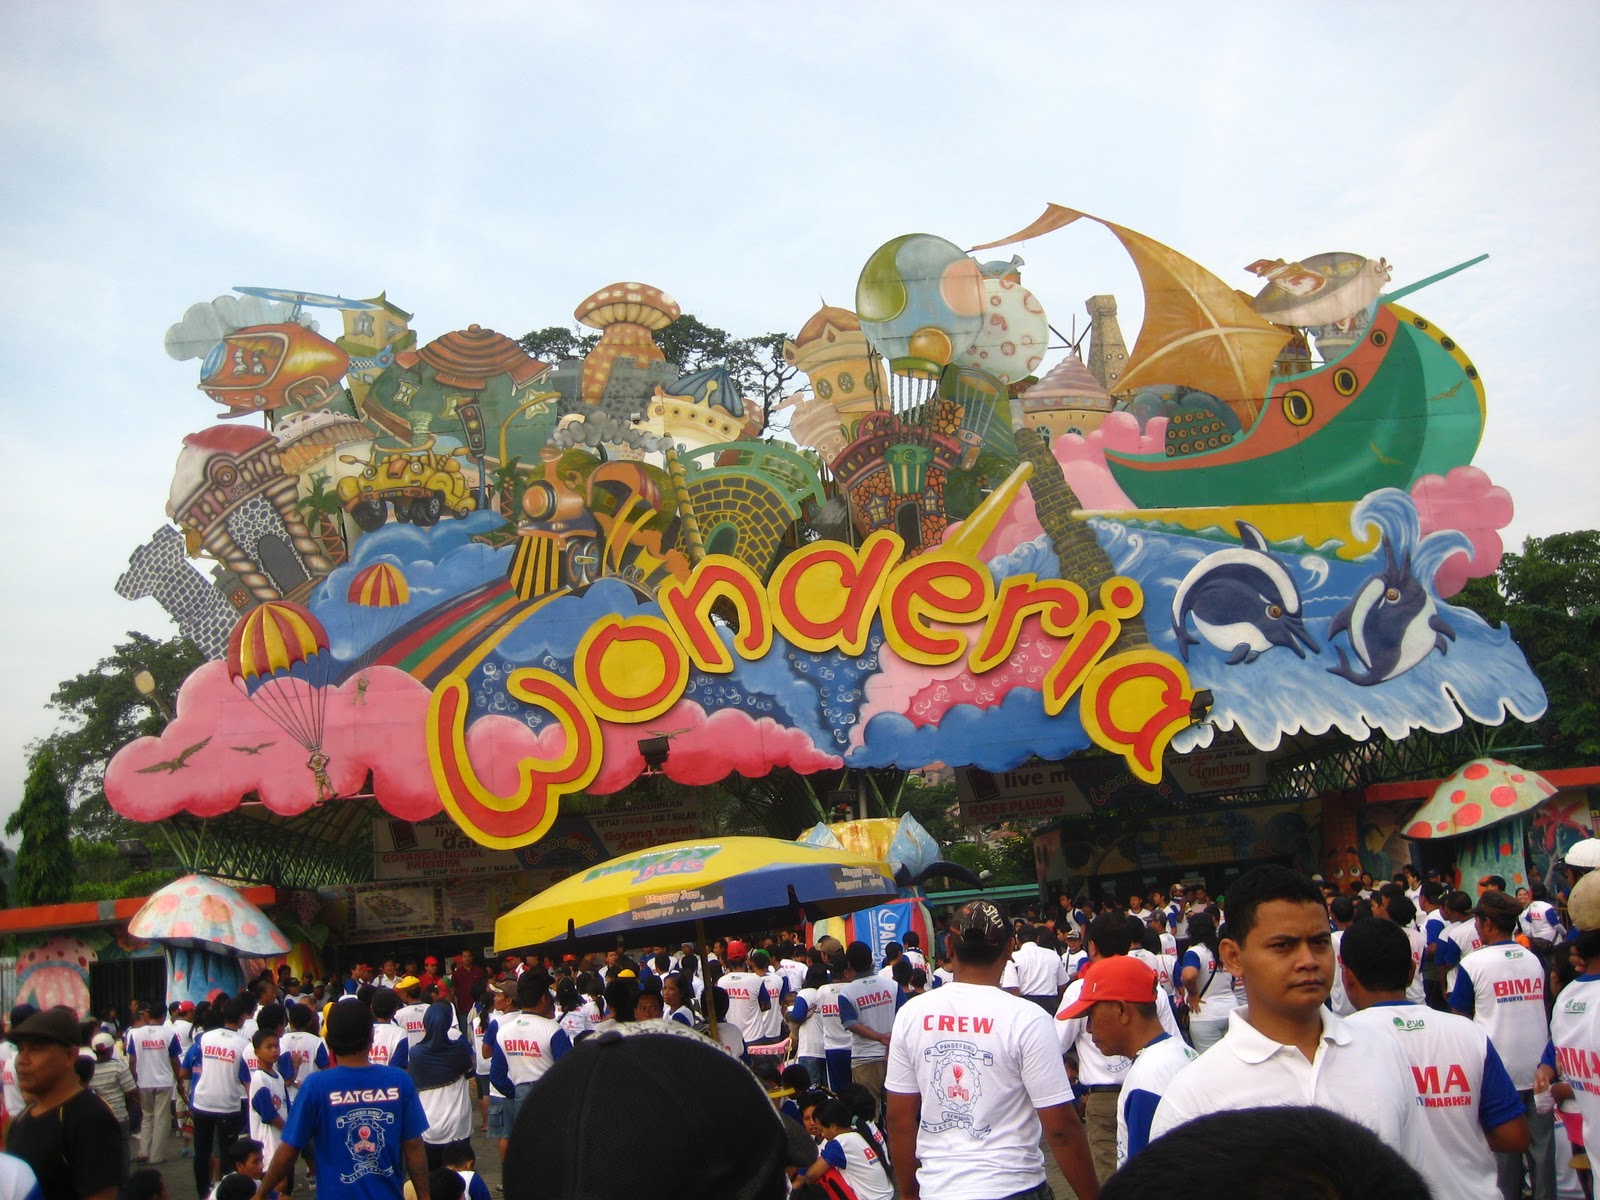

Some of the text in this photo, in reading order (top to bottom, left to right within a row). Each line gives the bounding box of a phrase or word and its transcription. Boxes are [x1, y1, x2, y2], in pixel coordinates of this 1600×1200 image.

[426, 529, 1196, 849] Wonderia
[1188, 761, 1251, 780] Tembang
[1004, 771, 1043, 788] live
[968, 796, 1064, 817] KOES PLUSAN
[597, 819, 620, 828] SETIAP
[622, 815, 649, 826] MINGGU
[672, 811, 697, 821] MALAM
[435, 826, 462, 838] live
[604, 825, 698, 842] Goyang Warak
[383, 852, 430, 863] GOYANG
[406, 859, 461, 869] PANTURA
[423, 868, 448, 876] SETIAP
[471, 865, 486, 873] JAM
[493, 863, 520, 871] MALAM
[645, 892, 681, 905] Happy
[1493, 978, 1542, 997] BIMA
[856, 989, 891, 1007] BIMA
[923, 1014, 994, 1035] CREW
[1407, 1019, 1425, 1029] esia
[142, 1040, 166, 1048] BIMA
[504, 1039, 541, 1053] BIMA
[940, 1042, 963, 1051] PANSER
[205, 1045, 236, 1060] BIMA
[1408, 1064, 1471, 1094] MA
[329, 1087, 400, 1106] SATGAS
[933, 1122, 953, 1132] SATU
